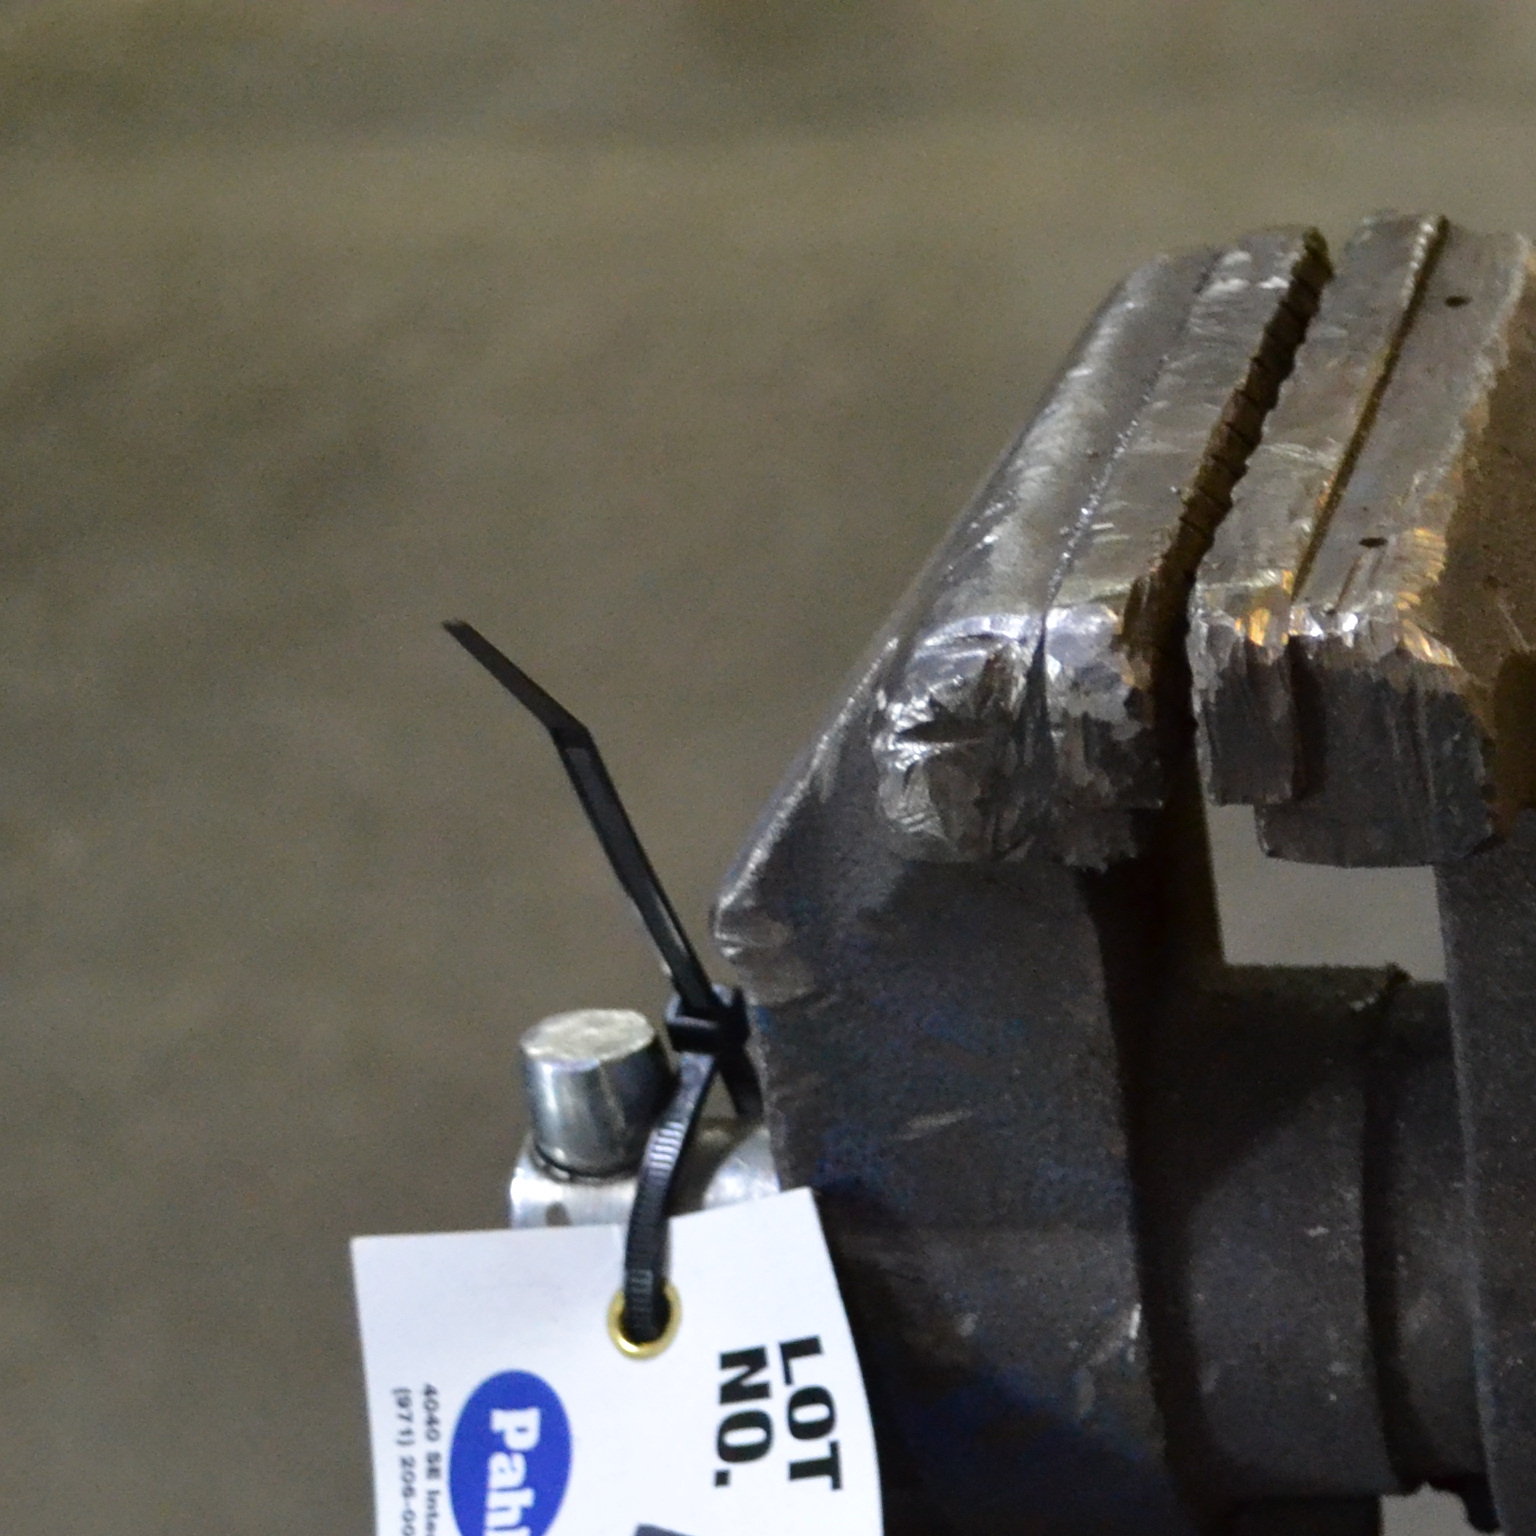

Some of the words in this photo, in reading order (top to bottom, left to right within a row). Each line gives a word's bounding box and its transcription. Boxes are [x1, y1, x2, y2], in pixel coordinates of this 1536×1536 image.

[422, 1384, 440, 1442] 4040
[712, 1346, 773, 1488] NO.
[778, 1335, 842, 1491] LOT
[424, 1452, 440, 1481] SE
